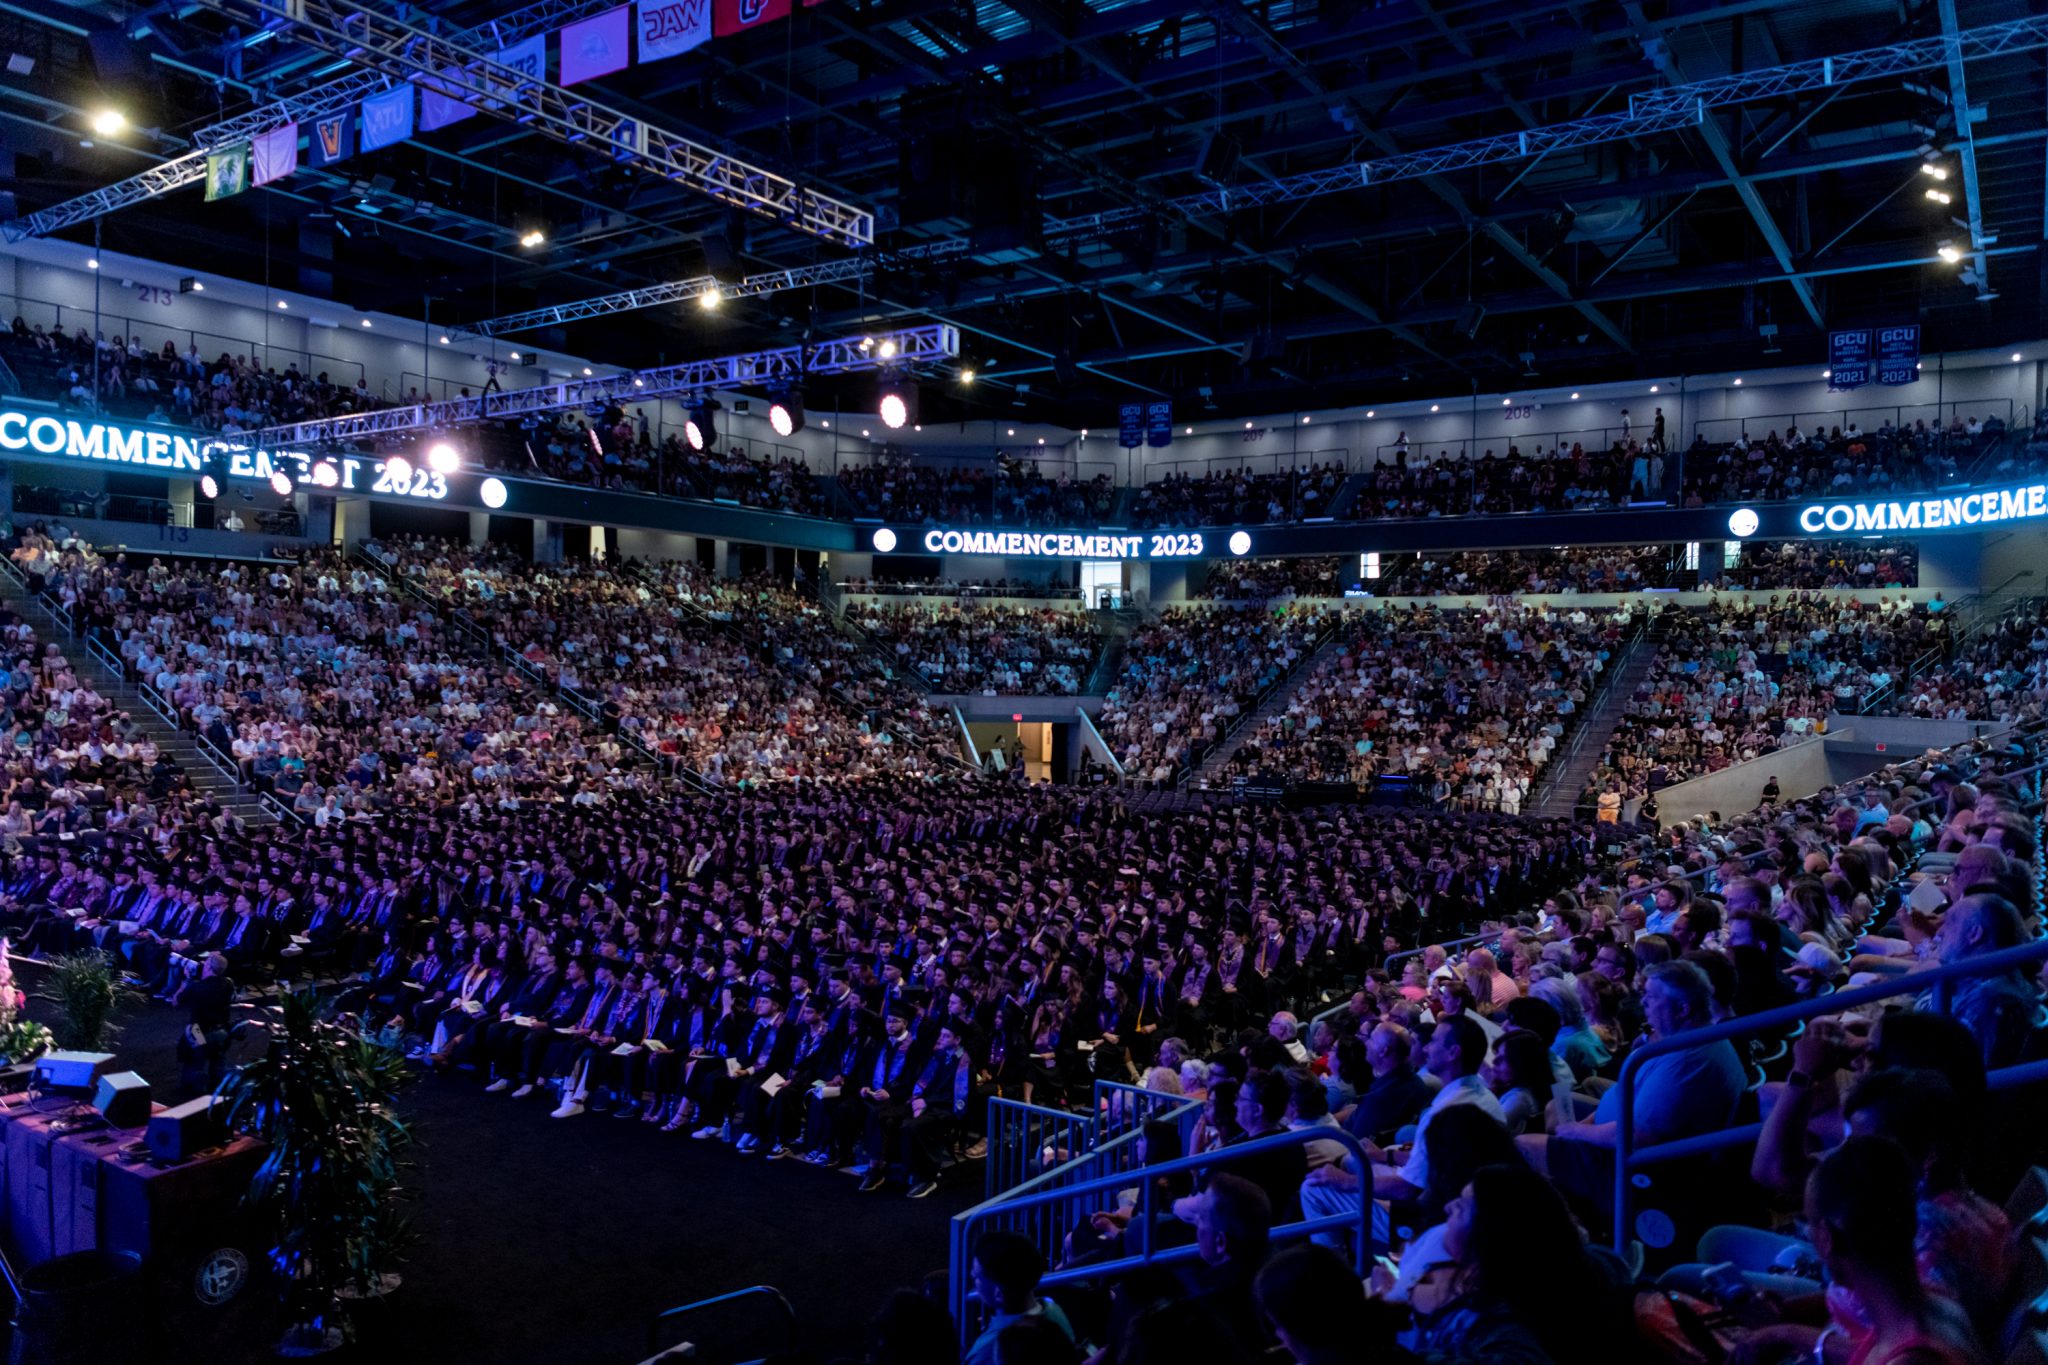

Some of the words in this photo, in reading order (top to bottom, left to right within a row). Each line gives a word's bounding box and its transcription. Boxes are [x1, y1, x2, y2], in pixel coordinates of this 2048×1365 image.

[138, 285, 172, 306] 213
[1834, 333, 1867, 347] GCU
[1881, 328, 1915, 343] GCU
[1834, 370, 1865, 384] 2021
[1881, 370, 1913, 383] 2021
[1122, 406, 1141, 416] GCU
[1149, 404, 1169, 415] GCU
[1505, 406, 1530, 420] 208
[1800, 485, 2048, 532] COMMENCEME
[158, 524, 188, 543] 113
[925, 530, 1143, 557] COMMENCEMENT
[1150, 534, 1203, 556] 2023
